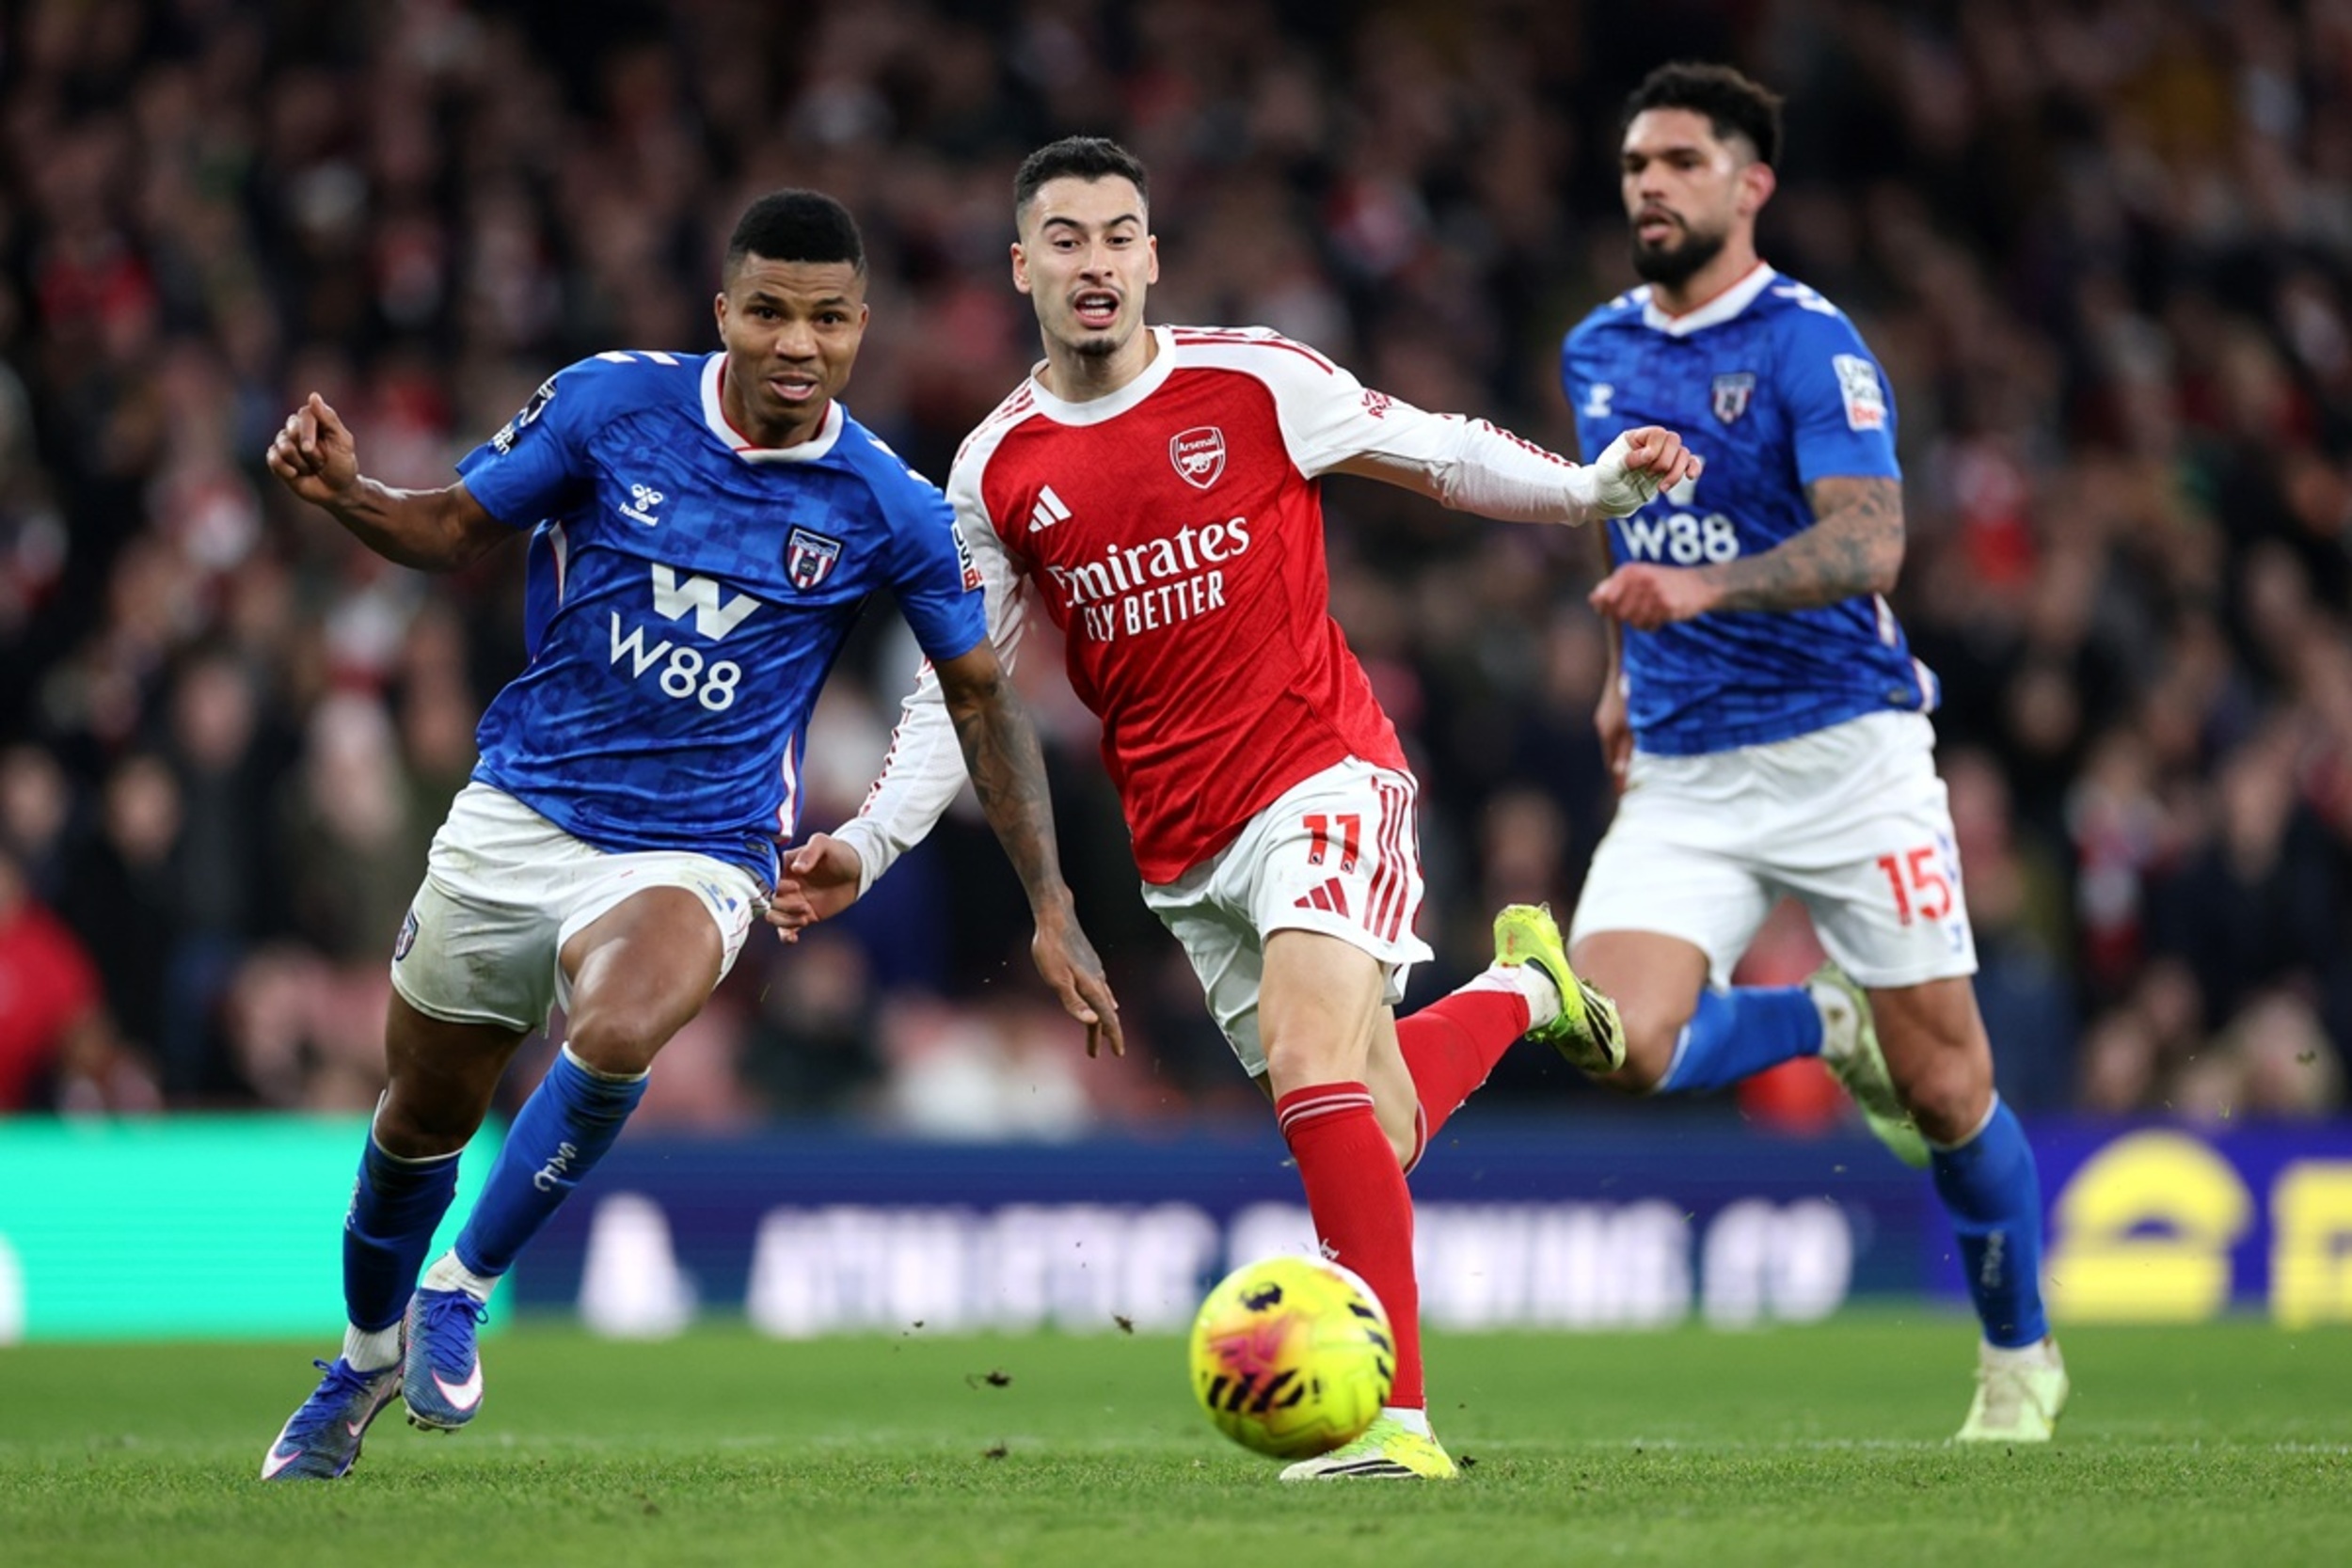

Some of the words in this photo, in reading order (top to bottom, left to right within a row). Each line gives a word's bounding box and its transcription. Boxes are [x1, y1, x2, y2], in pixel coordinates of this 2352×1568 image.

[1178, 436, 1217, 451] Arsenal
[1045, 516, 1250, 609] Emirates
[1616, 513, 1740, 564] W88
[1083, 604, 1114, 641] FLY
[1123, 569, 1226, 636] BETTER
[611, 610, 741, 711] W88
[1302, 813, 1360, 875] 11
[1877, 847, 1950, 927] 15
